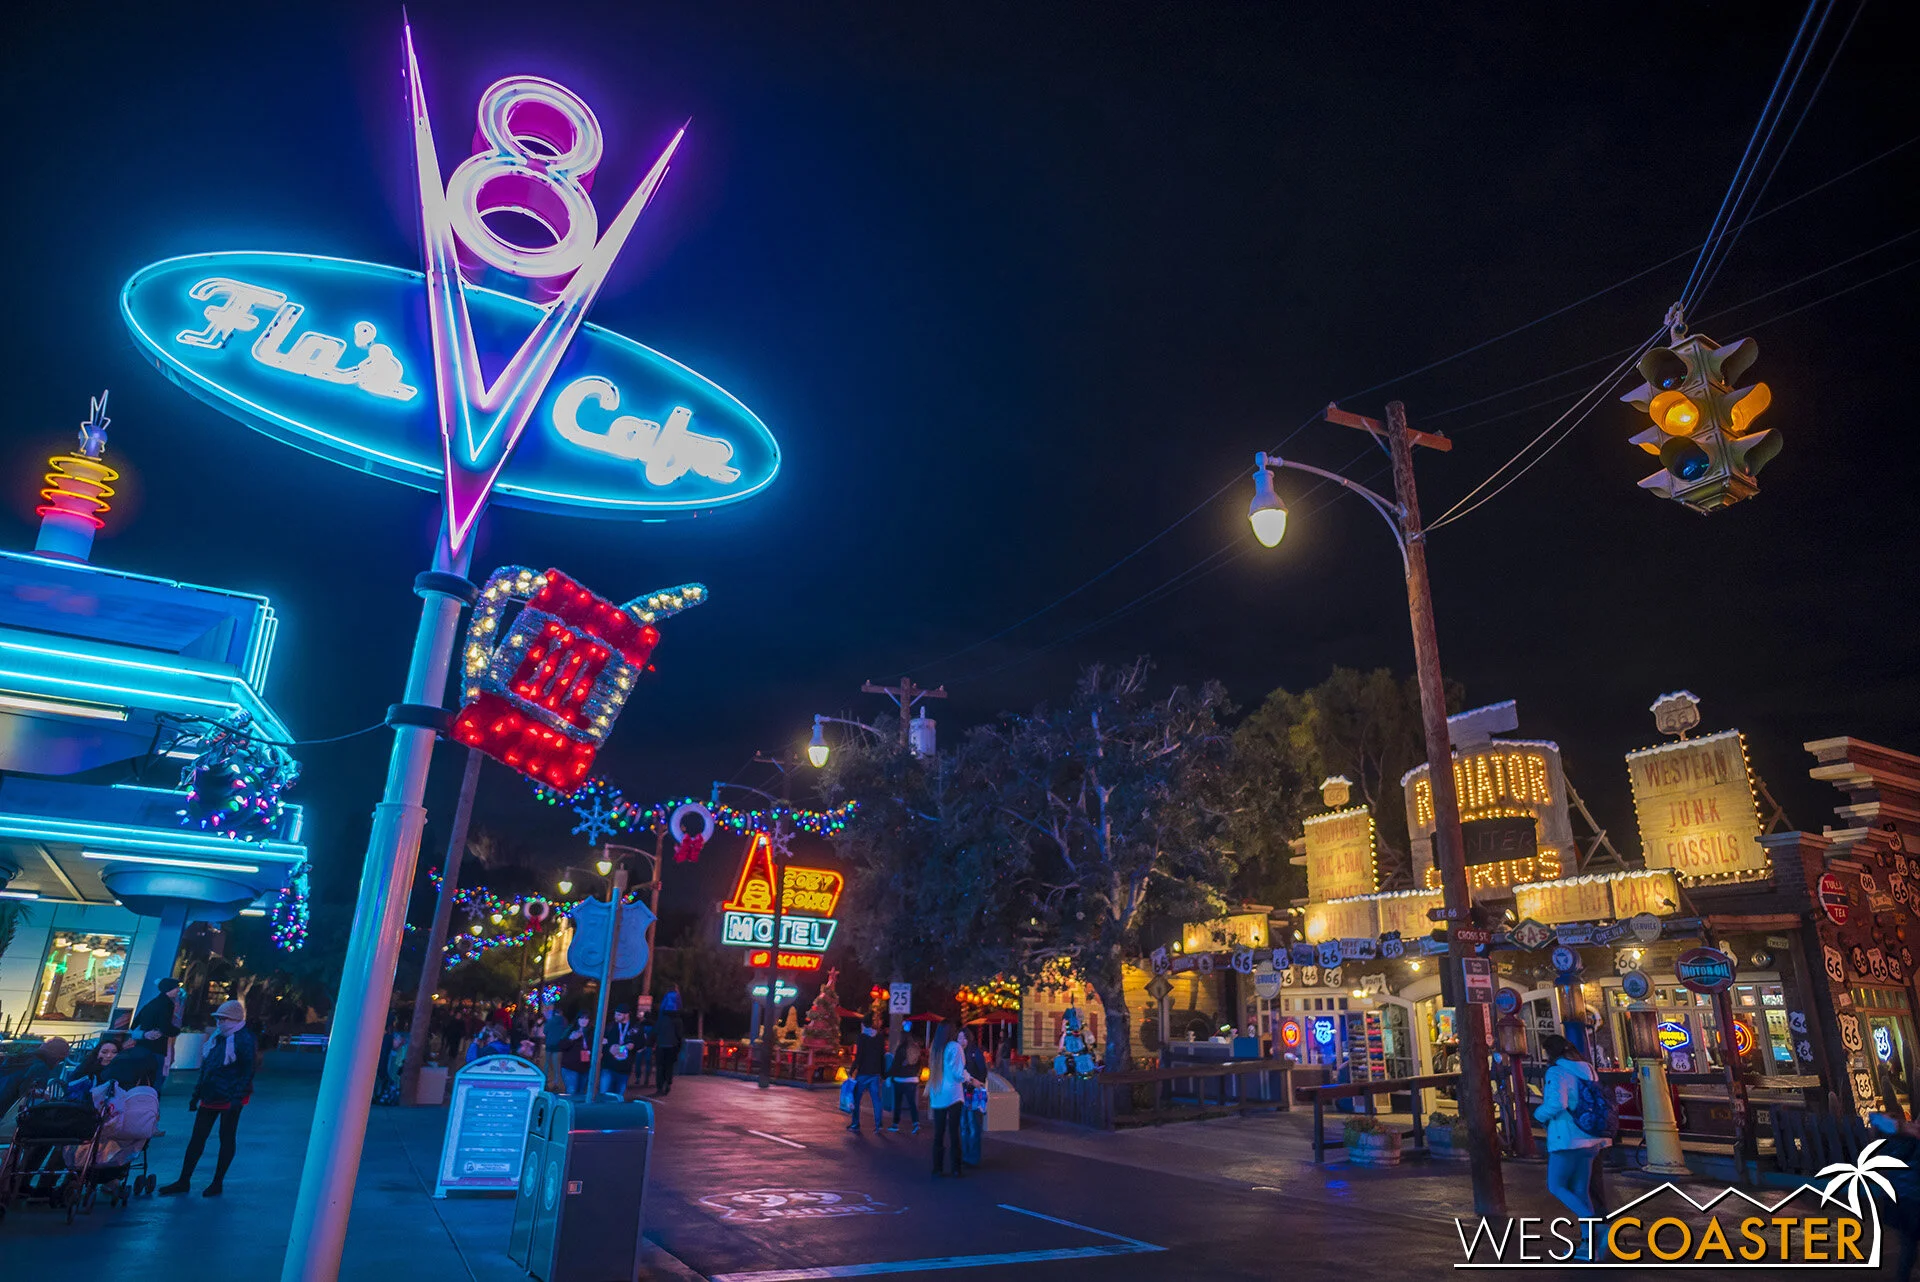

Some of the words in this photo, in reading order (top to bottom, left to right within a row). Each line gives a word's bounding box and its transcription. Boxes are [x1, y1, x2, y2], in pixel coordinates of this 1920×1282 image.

[1665, 710, 1689, 730] 66
[1643, 750, 1729, 787] WESTERN
[1668, 796, 1722, 828] JUNK
[1666, 834, 1740, 868] FOSSILS
[1615, 878, 1665, 913] CAPS
[1893, 883, 1908, 901] 66
[1448, 908, 1457, 917] 66
[1834, 907, 1846, 918] TEA
[728, 915, 825, 946] MOTEL
[1457, 931, 1479, 940] CROSS
[1595, 930, 1611, 942] ONE
[1385, 941, 1400, 957] 66
[1234, 952, 1250, 968] 66
[1275, 957, 1286, 967] 66
[1321, 952, 1340, 965] 66
[1618, 953, 1637, 970] 66
[1681, 963, 1713, 978] MOTOR
[1714, 962, 1730, 978] OIL
[1827, 957, 1842, 978] 66
[1872, 959, 1886, 978] 66
[1304, 971, 1317, 981] 66
[1325, 971, 1340, 985] 66
[893, 991, 908, 1006] 25
[1844, 1026, 1859, 1046] 66
[1675, 1062, 1687, 1070] 66
[1859, 1079, 1870, 1092] 66
